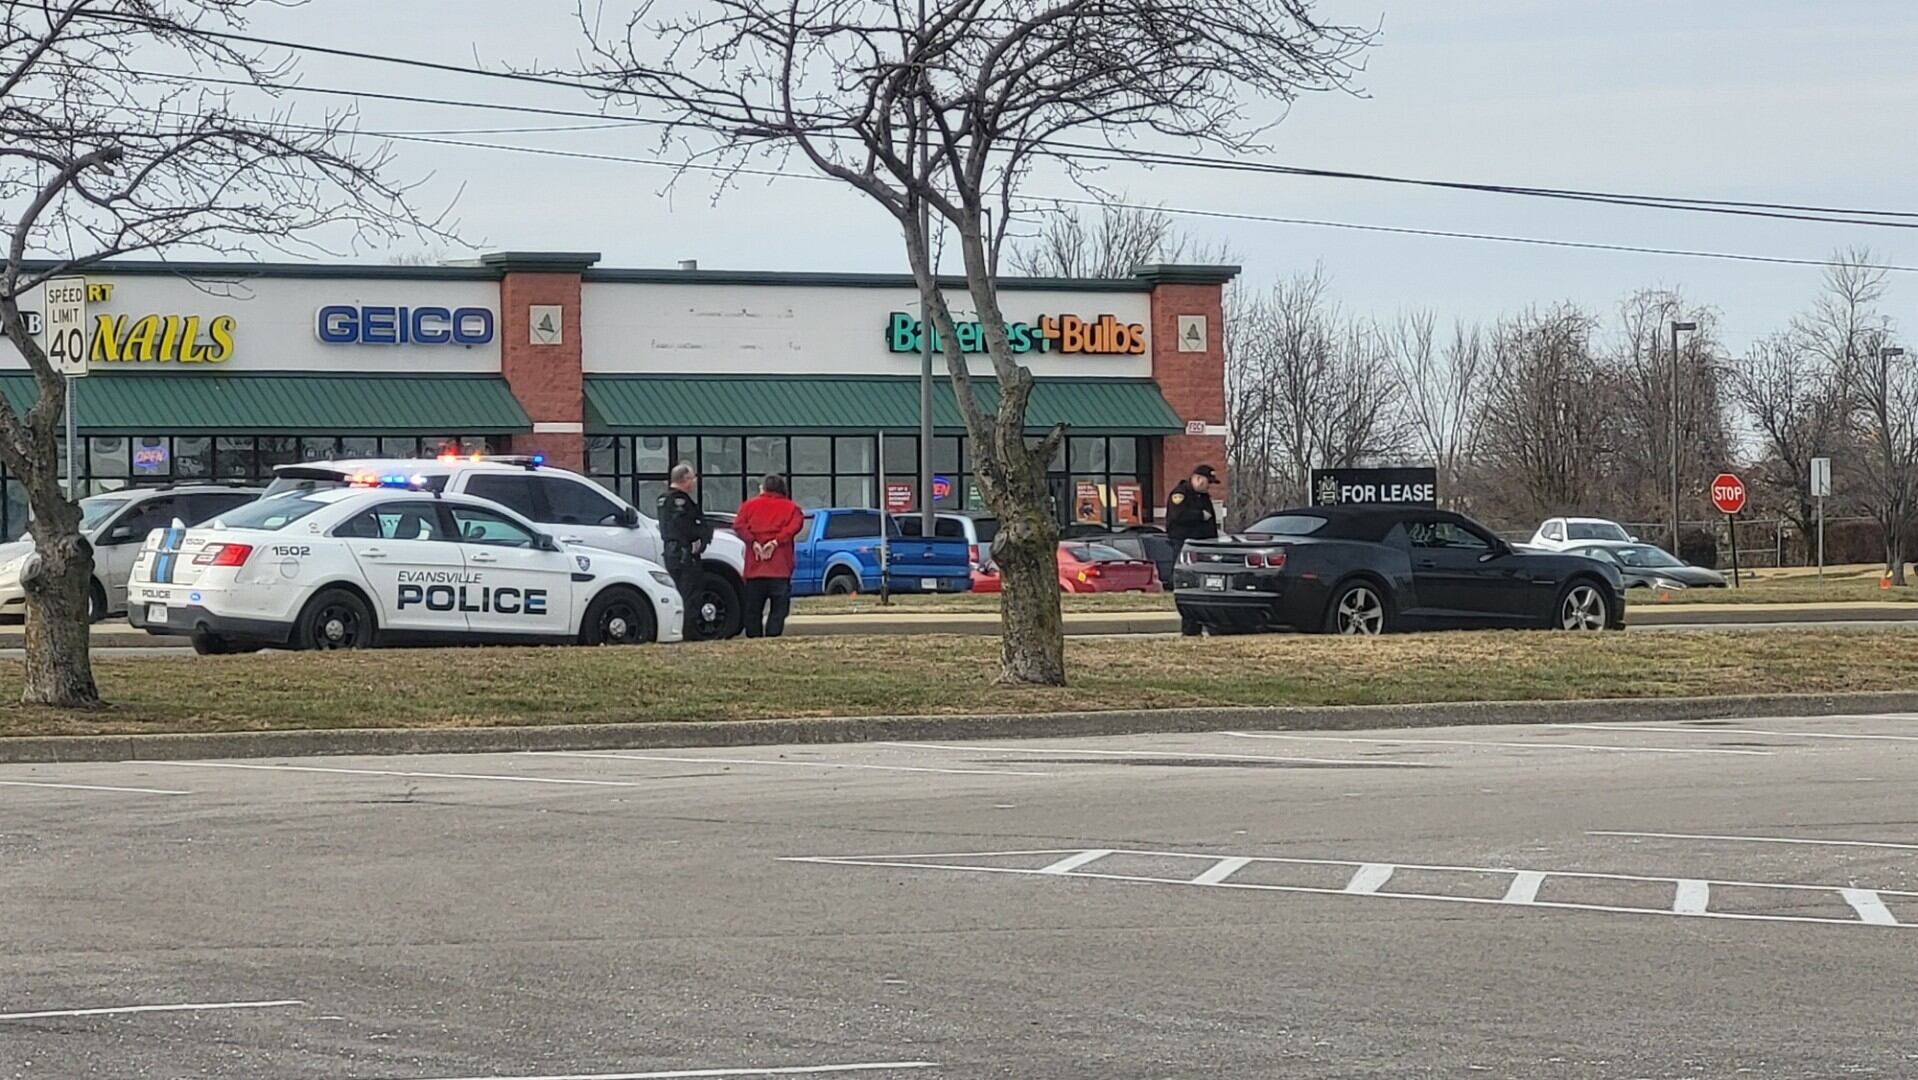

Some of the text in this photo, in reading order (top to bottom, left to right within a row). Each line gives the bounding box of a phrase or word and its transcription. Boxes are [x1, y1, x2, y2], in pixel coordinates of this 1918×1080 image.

[49, 288, 82, 304] SPEED
[87, 284, 114, 303] RT
[53, 308, 79, 323] LIMIT
[317, 305, 494, 344] GEICO
[89, 313, 236, 363] NAILS
[1060, 314, 1146, 354] Bulbs
[50, 328, 83, 363] 40
[1341, 483, 1434, 503] FOR LEASE
[1714, 486, 1742, 501] STOP
[272, 545, 312, 557] 1502
[397, 570, 483, 584] EVANSVILLE
[142, 589, 171, 599] POLICE
[397, 584, 548, 615] POLICE
